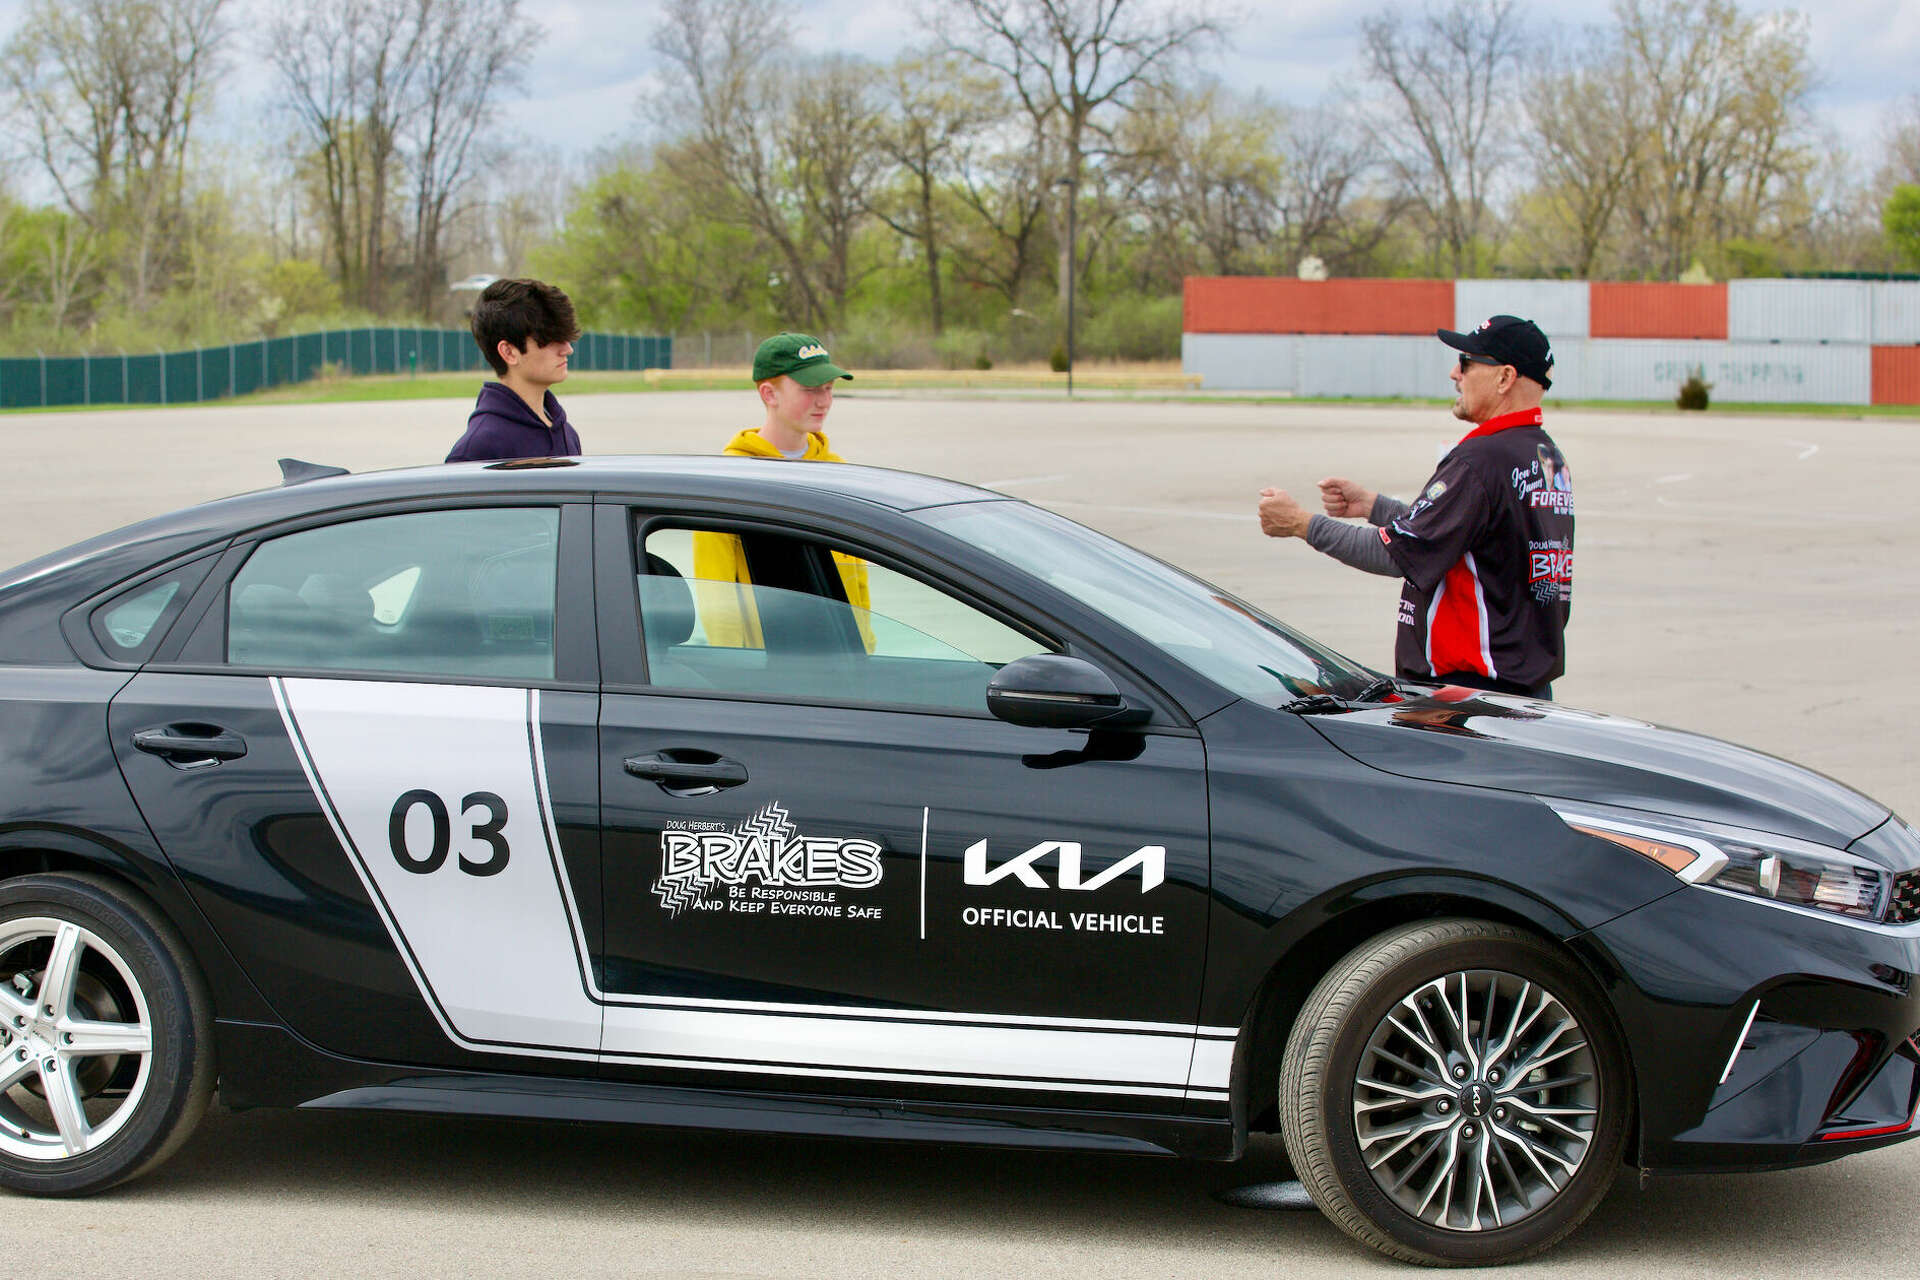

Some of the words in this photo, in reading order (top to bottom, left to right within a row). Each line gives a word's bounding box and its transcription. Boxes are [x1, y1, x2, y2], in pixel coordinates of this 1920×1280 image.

[388, 788, 511, 877] 03
[666, 820, 686, 830] DOUG
[688, 821, 726, 832] HERBERT'S
[728, 886, 746, 898] BE
[751, 887, 836, 903] RESPONSIBLE
[693, 899, 724, 912] AND
[729, 902, 765, 914] KEEP
[770, 902, 842, 918] EVERYONE
[847, 905, 882, 919] SAFE
[962, 906, 1063, 930] OFFICIAL
[1069, 912, 1165, 935] VEHICLE
